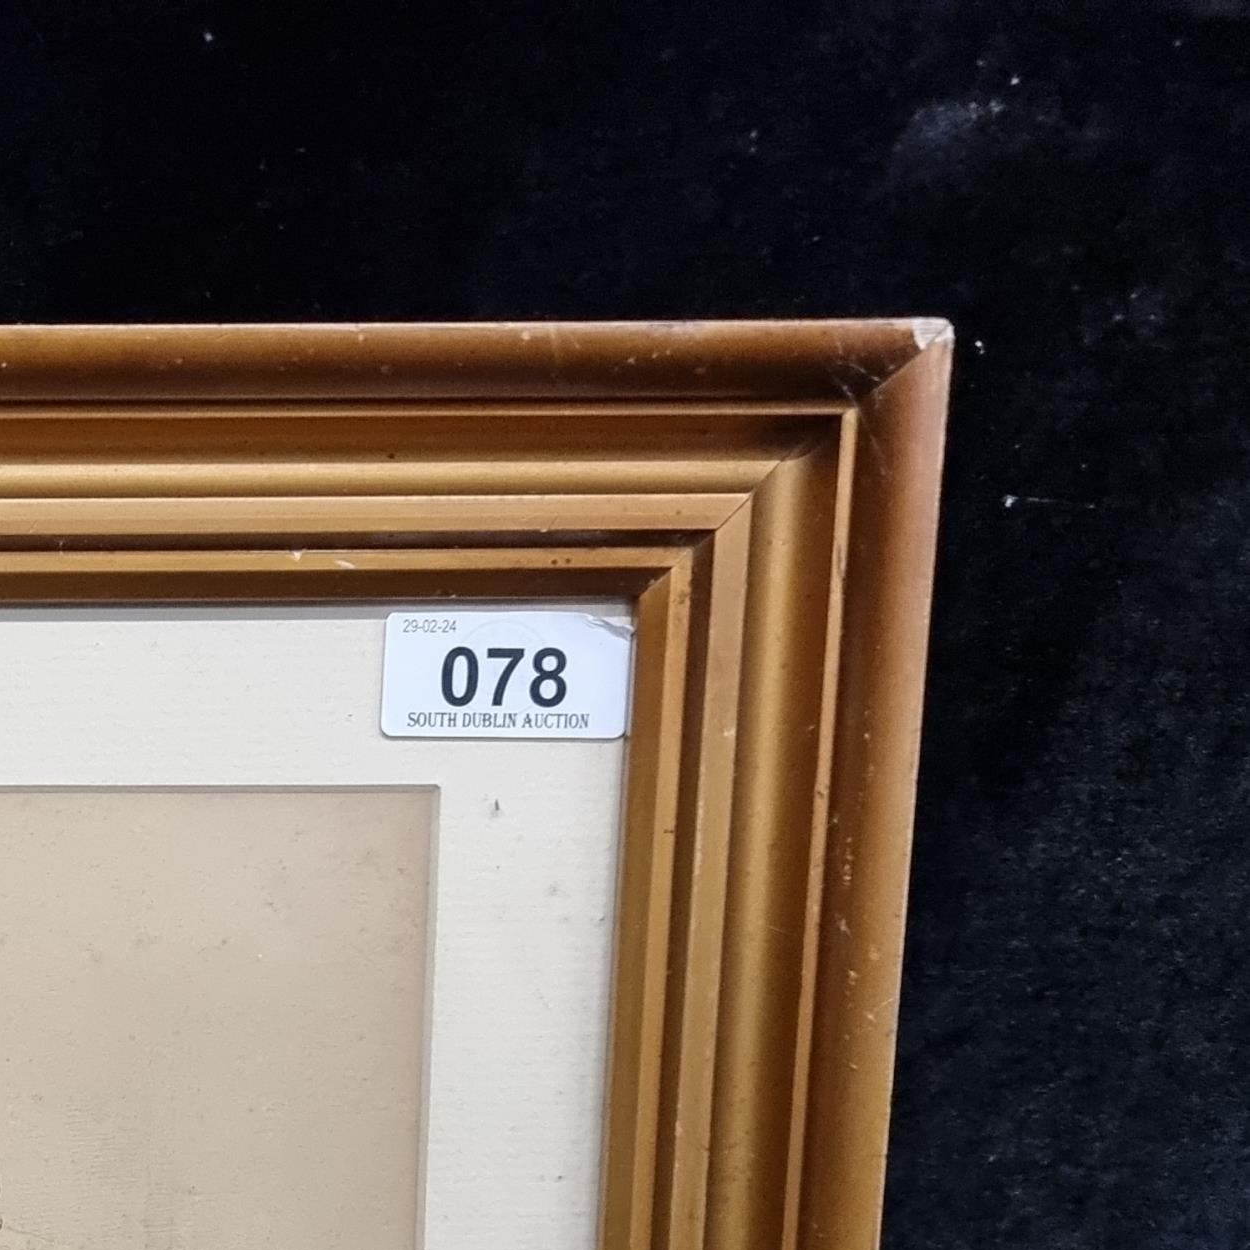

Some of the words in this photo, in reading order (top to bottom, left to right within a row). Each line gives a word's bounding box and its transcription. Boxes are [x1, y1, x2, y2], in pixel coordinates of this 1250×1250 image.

[402, 618, 457, 634] 29-02-24
[440, 646, 568, 708] 078
[406, 711, 457, 728] SOUTH
[462, 712, 517, 728] DUBLIN
[521, 712, 590, 729] AUCTION
